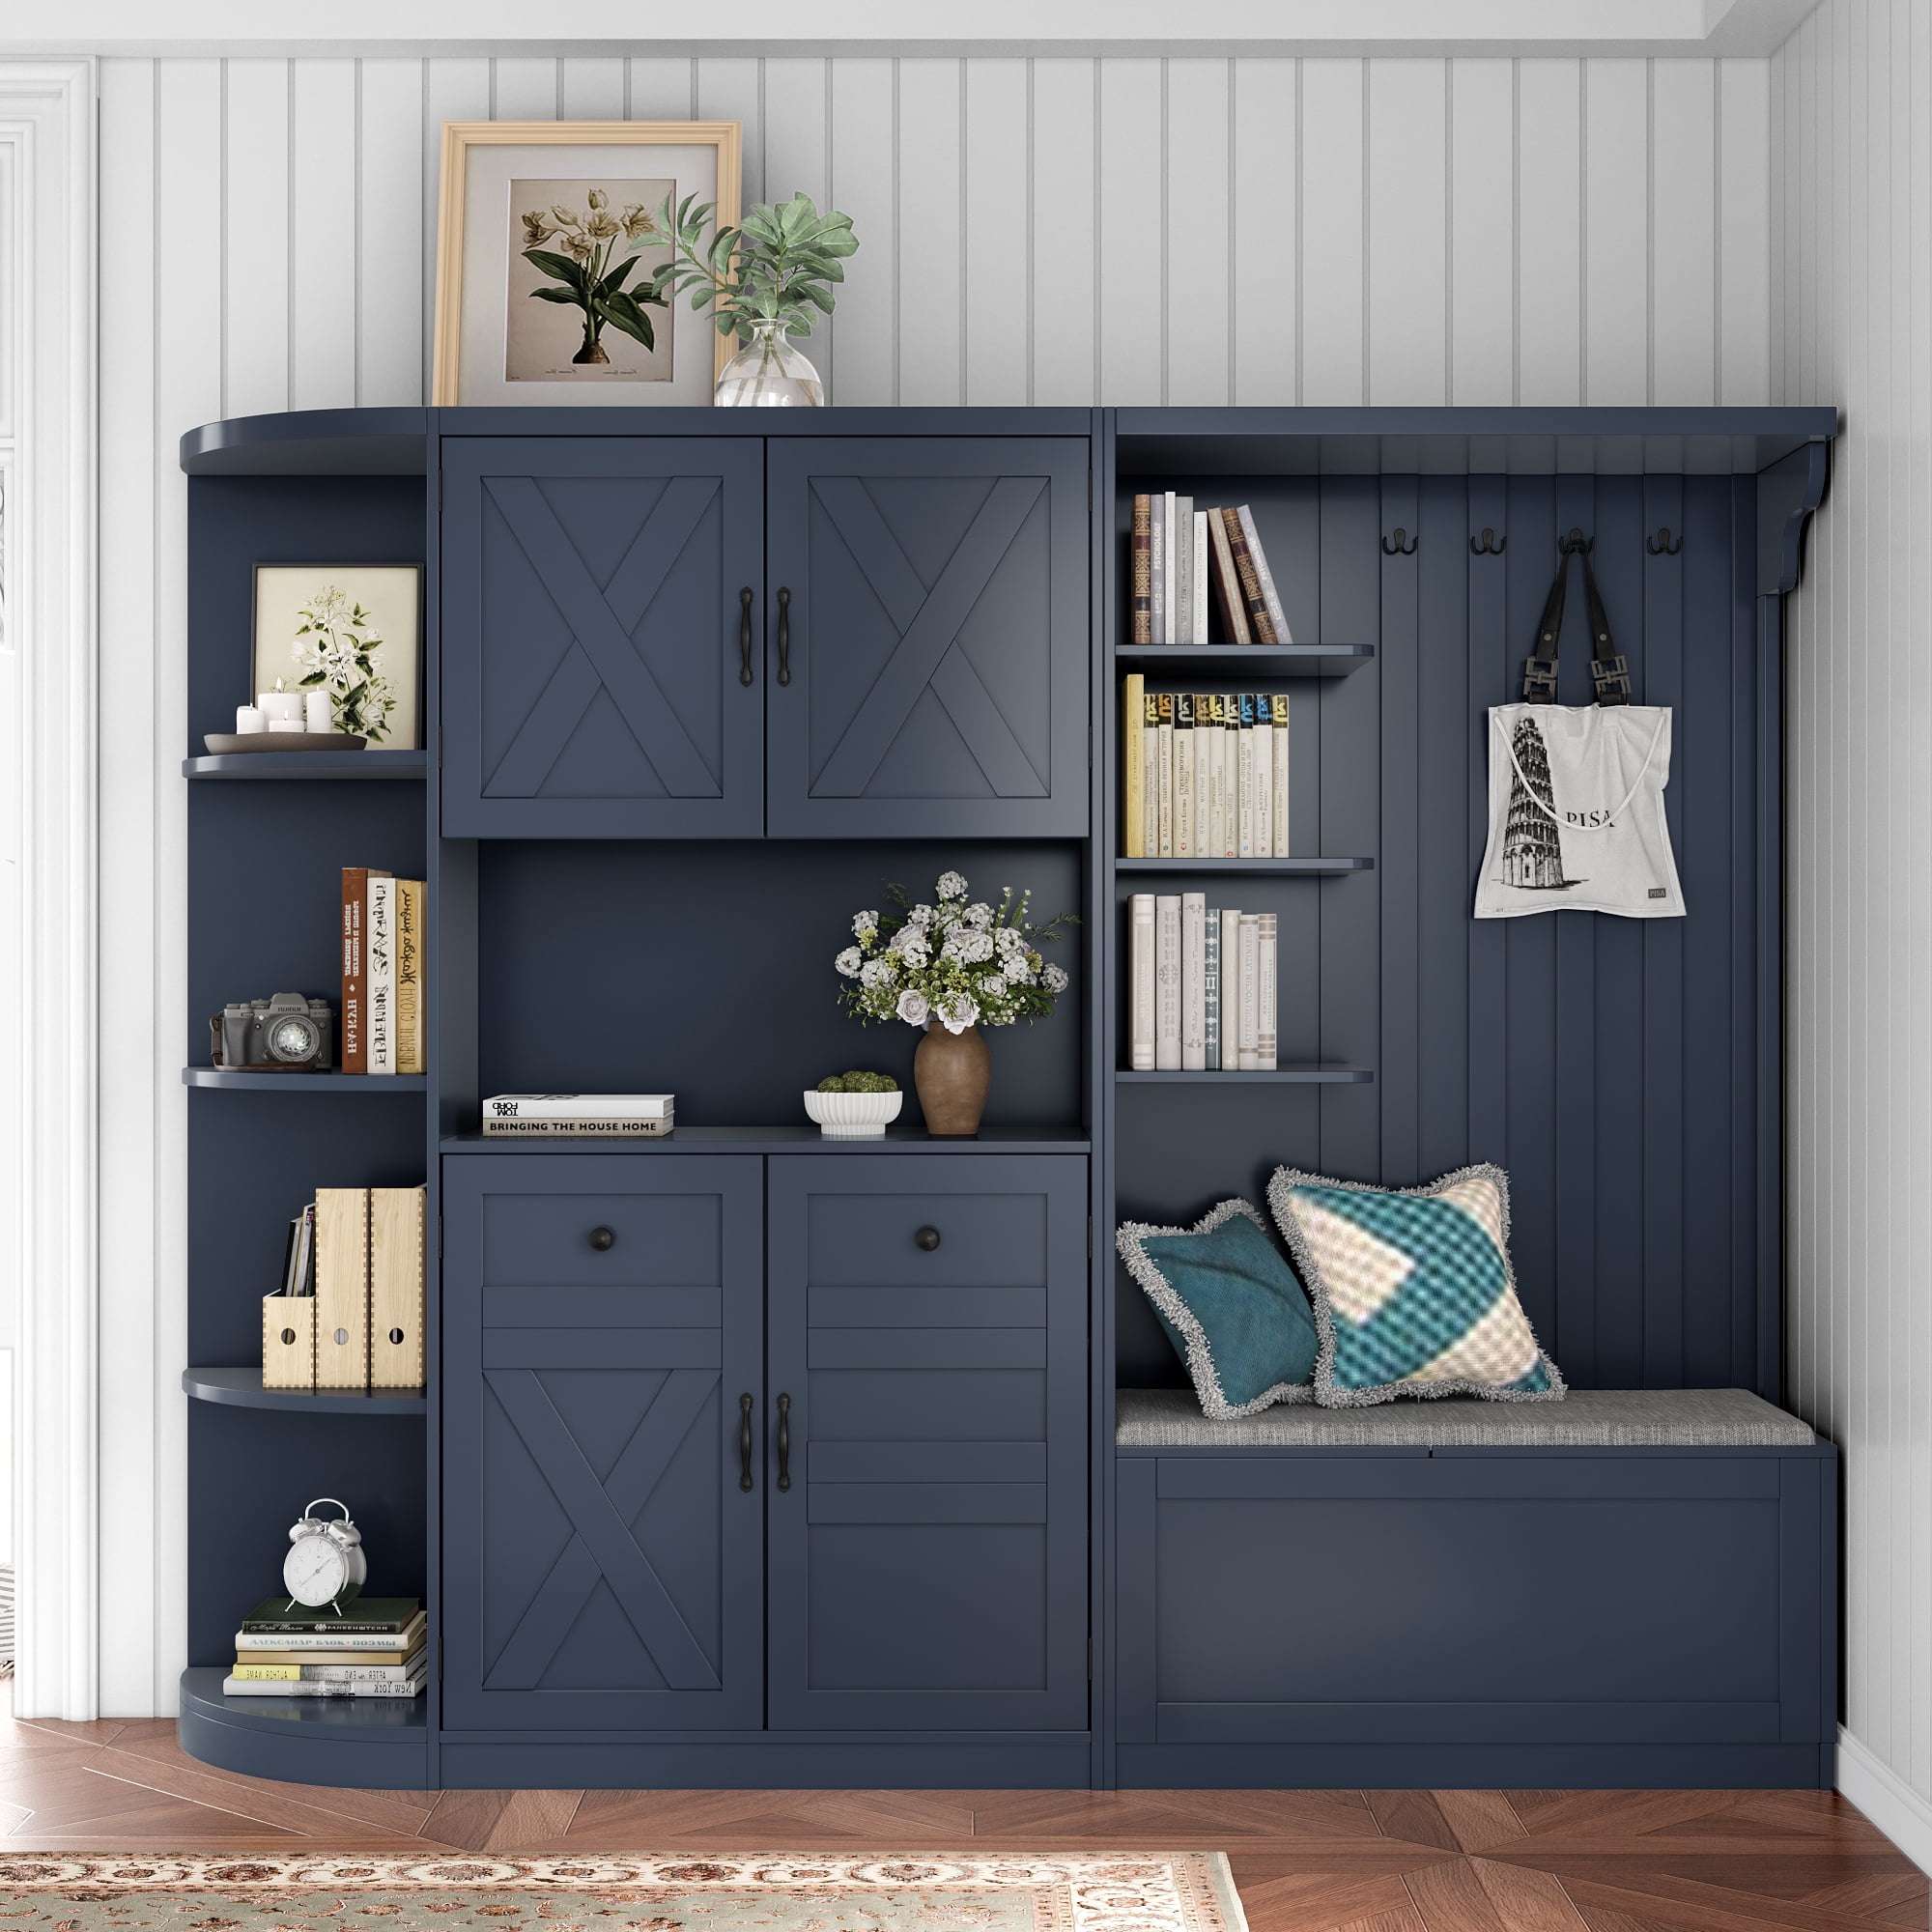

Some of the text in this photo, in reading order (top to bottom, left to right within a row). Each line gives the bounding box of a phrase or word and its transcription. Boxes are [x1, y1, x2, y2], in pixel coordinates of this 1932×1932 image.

[1566, 810, 1615, 828] PISA
[1650, 890, 1665, 898] PISA
[490, 1122, 549, 1131] BRINGING
